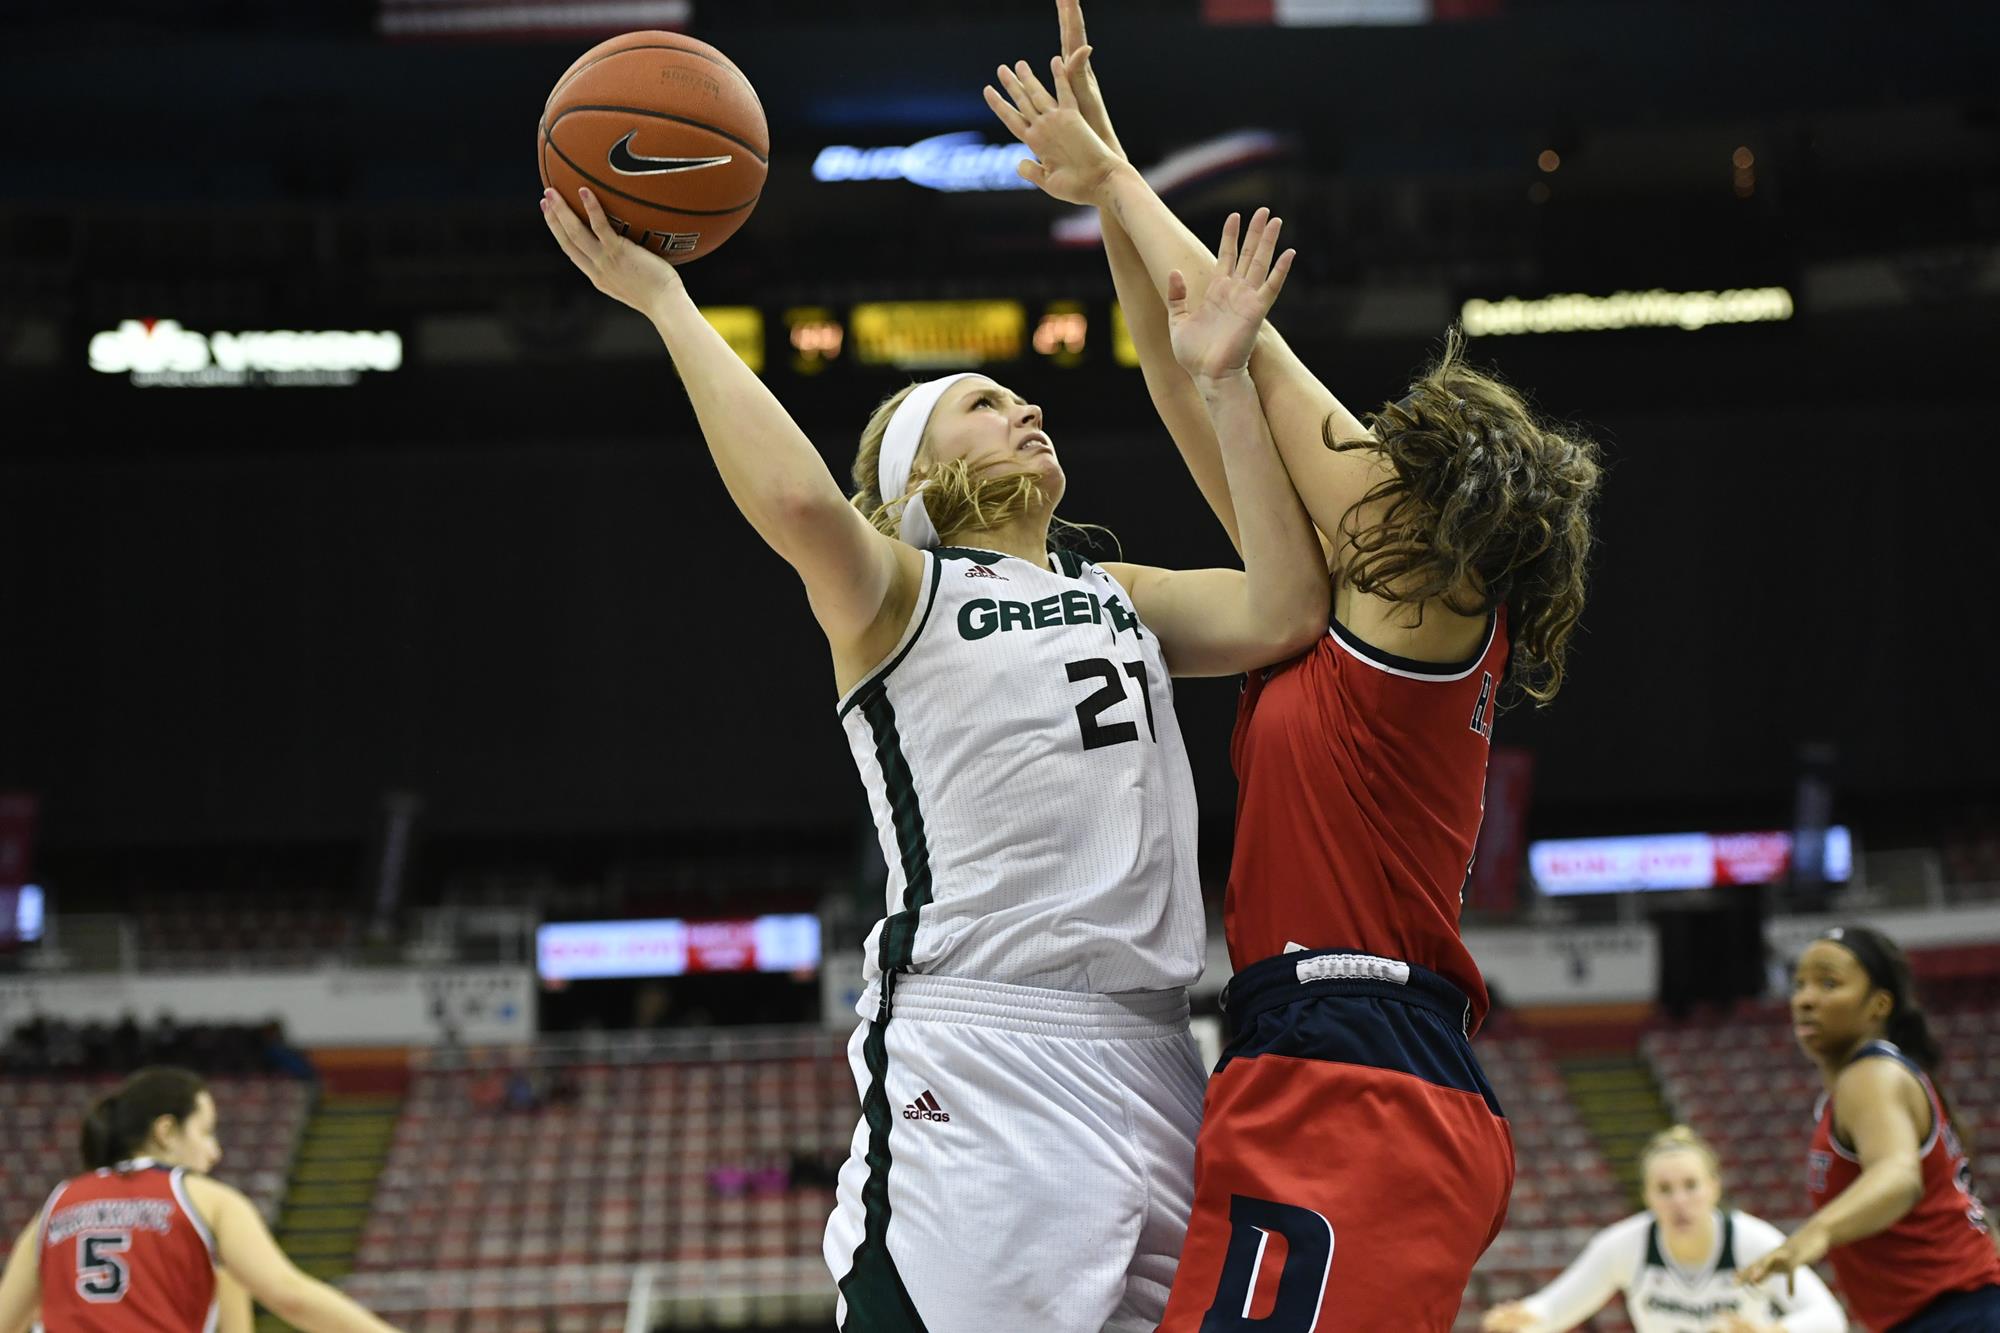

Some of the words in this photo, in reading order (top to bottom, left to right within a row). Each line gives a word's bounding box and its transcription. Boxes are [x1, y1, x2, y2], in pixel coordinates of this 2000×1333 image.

[1064, 657, 1157, 751] 21
[902, 1109, 951, 1122] adidas
[75, 1229, 131, 1304] 5
[1198, 1193, 1336, 1333] D
